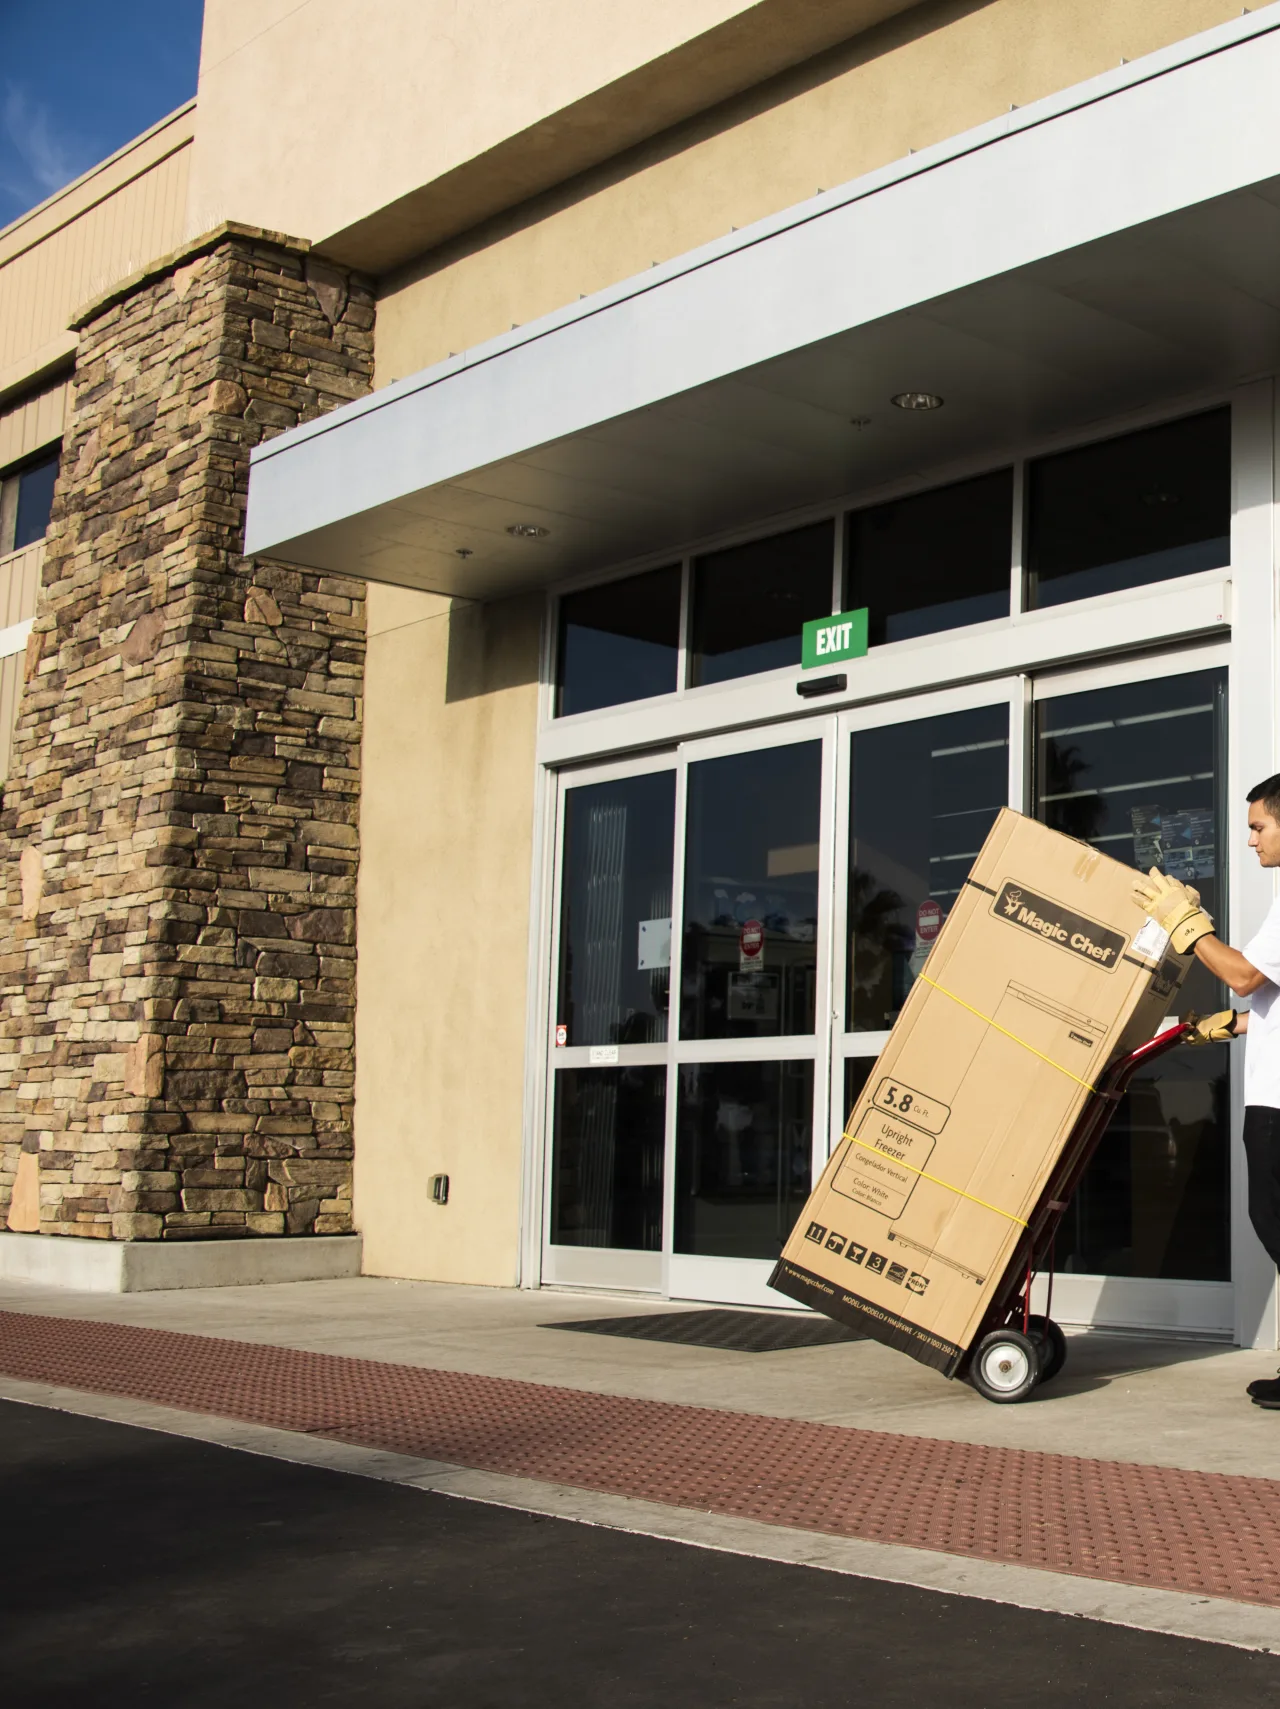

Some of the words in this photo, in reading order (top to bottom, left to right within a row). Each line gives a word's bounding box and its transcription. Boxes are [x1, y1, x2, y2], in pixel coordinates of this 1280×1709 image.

[816, 622, 853, 656] EXIT
[920, 926, 938, 934] ENTER
[1017, 906, 1068, 942] Magic
[883, 1086, 913, 1113] 5.8
[881, 1123, 914, 1147] Upright
[874, 1138, 906, 1161] Freezer
[855, 1153, 887, 1173] Congelador
[887, 1167, 909, 1183] Vertical
[853, 1177, 871, 1191] Color:
[871, 1185, 889, 1200] White
[872, 1257, 882, 1269] 3
[908, 1277, 929, 1290] FRONT
